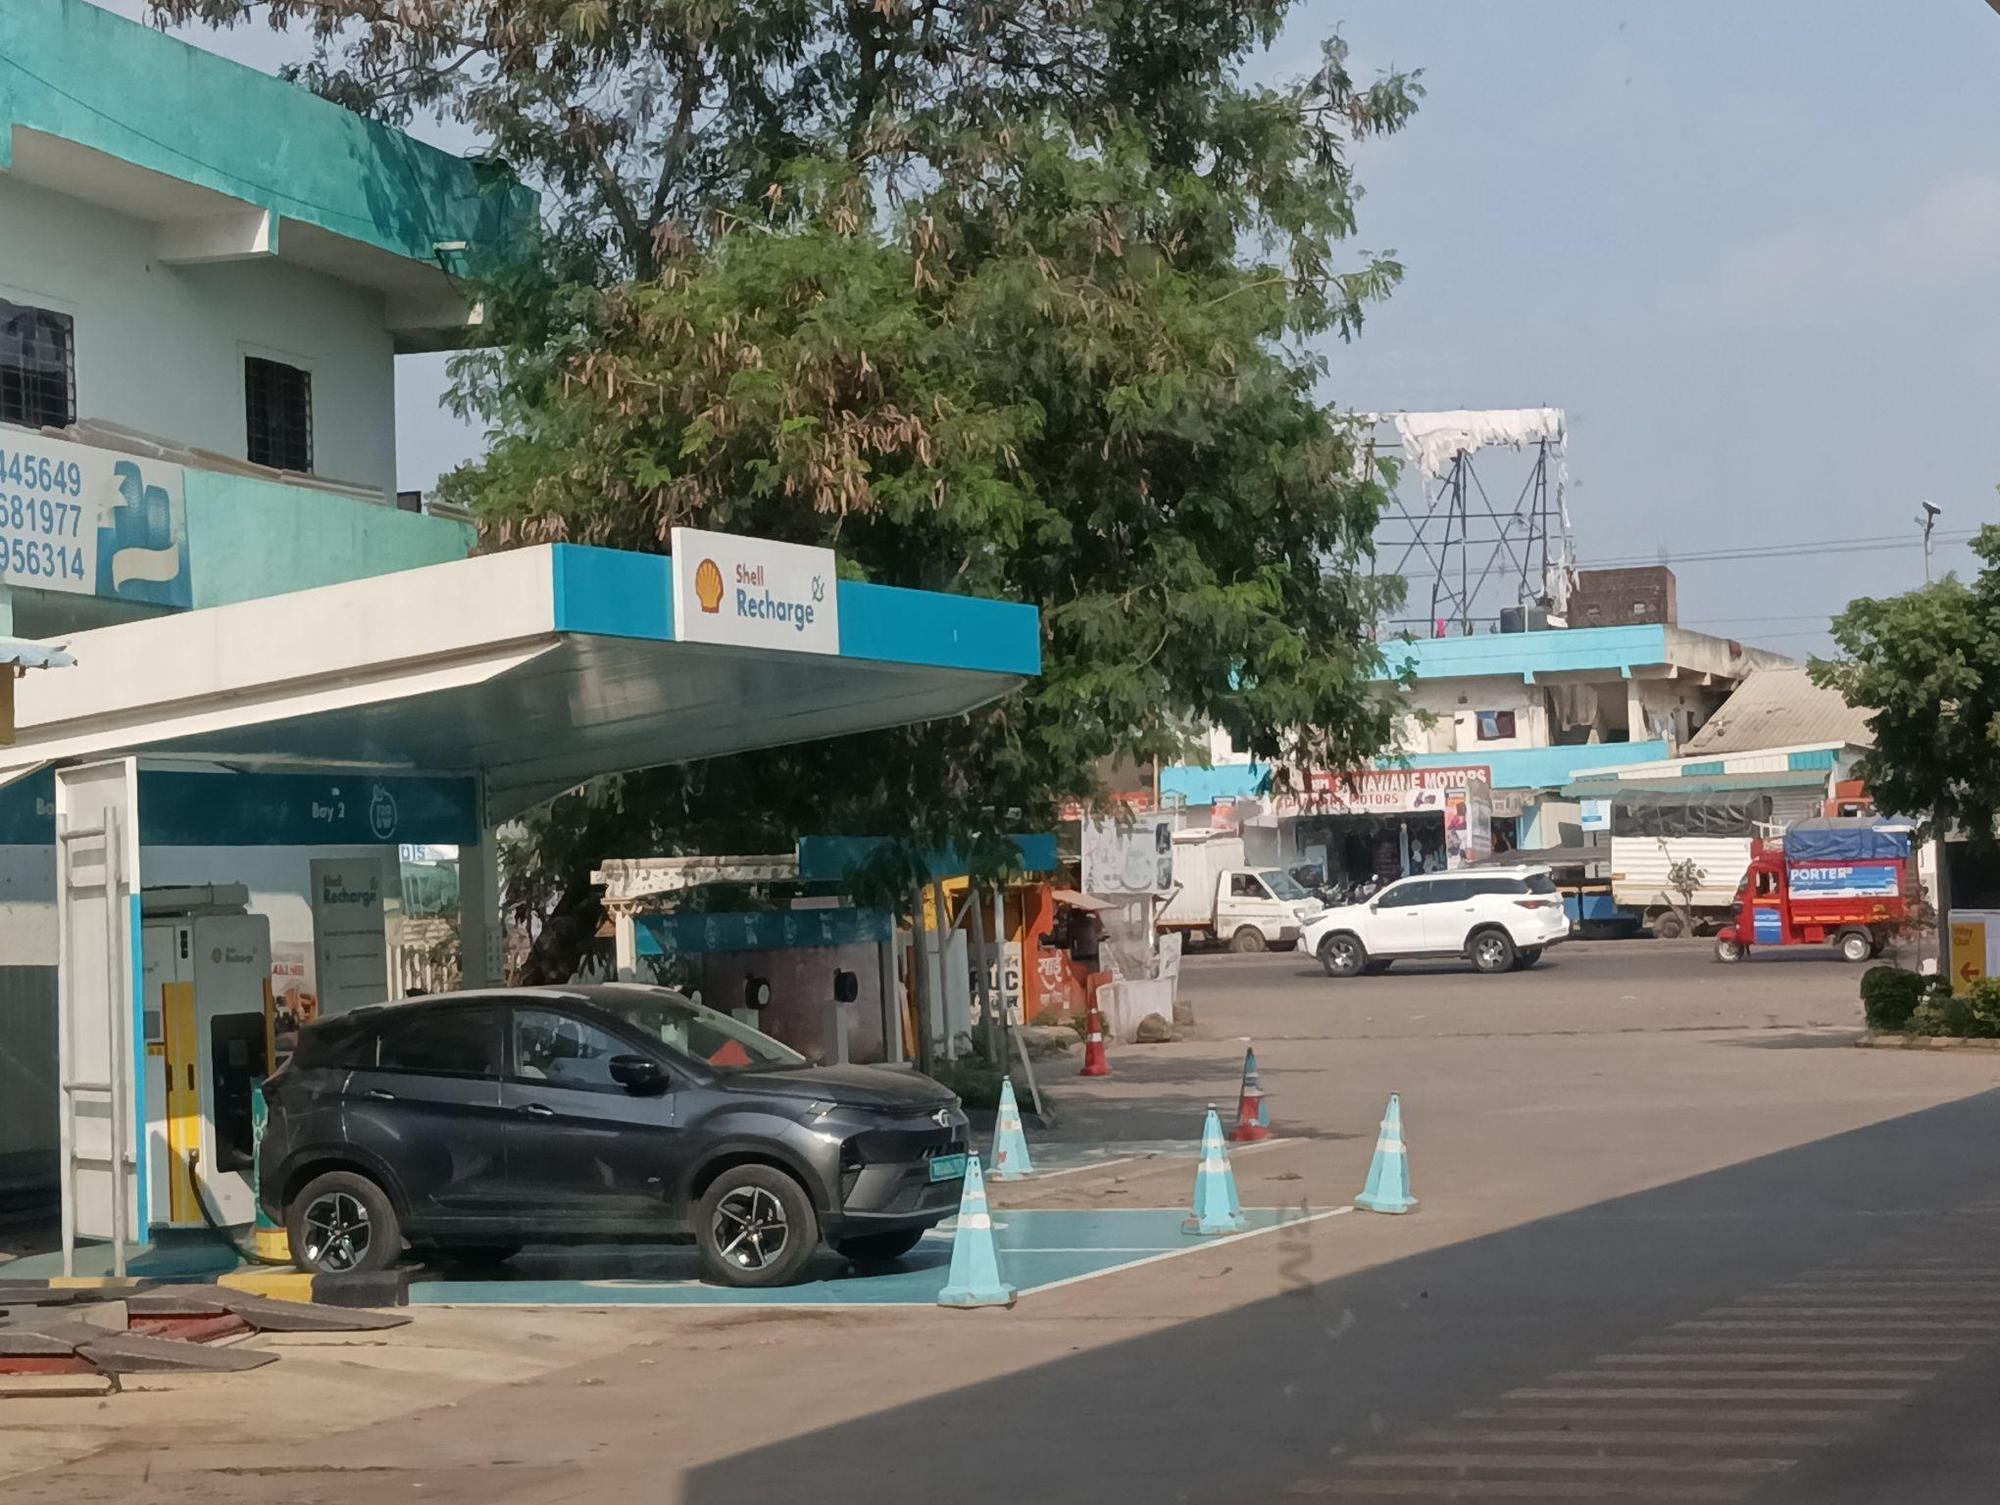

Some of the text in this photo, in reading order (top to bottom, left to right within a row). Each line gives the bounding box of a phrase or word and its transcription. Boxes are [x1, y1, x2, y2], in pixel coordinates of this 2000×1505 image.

[736, 563, 764, 587] Shell
[736, 588, 815, 632] Recharge
[312, 801, 345, 822] Bay 2
[1790, 868, 1847, 881] PORTER
